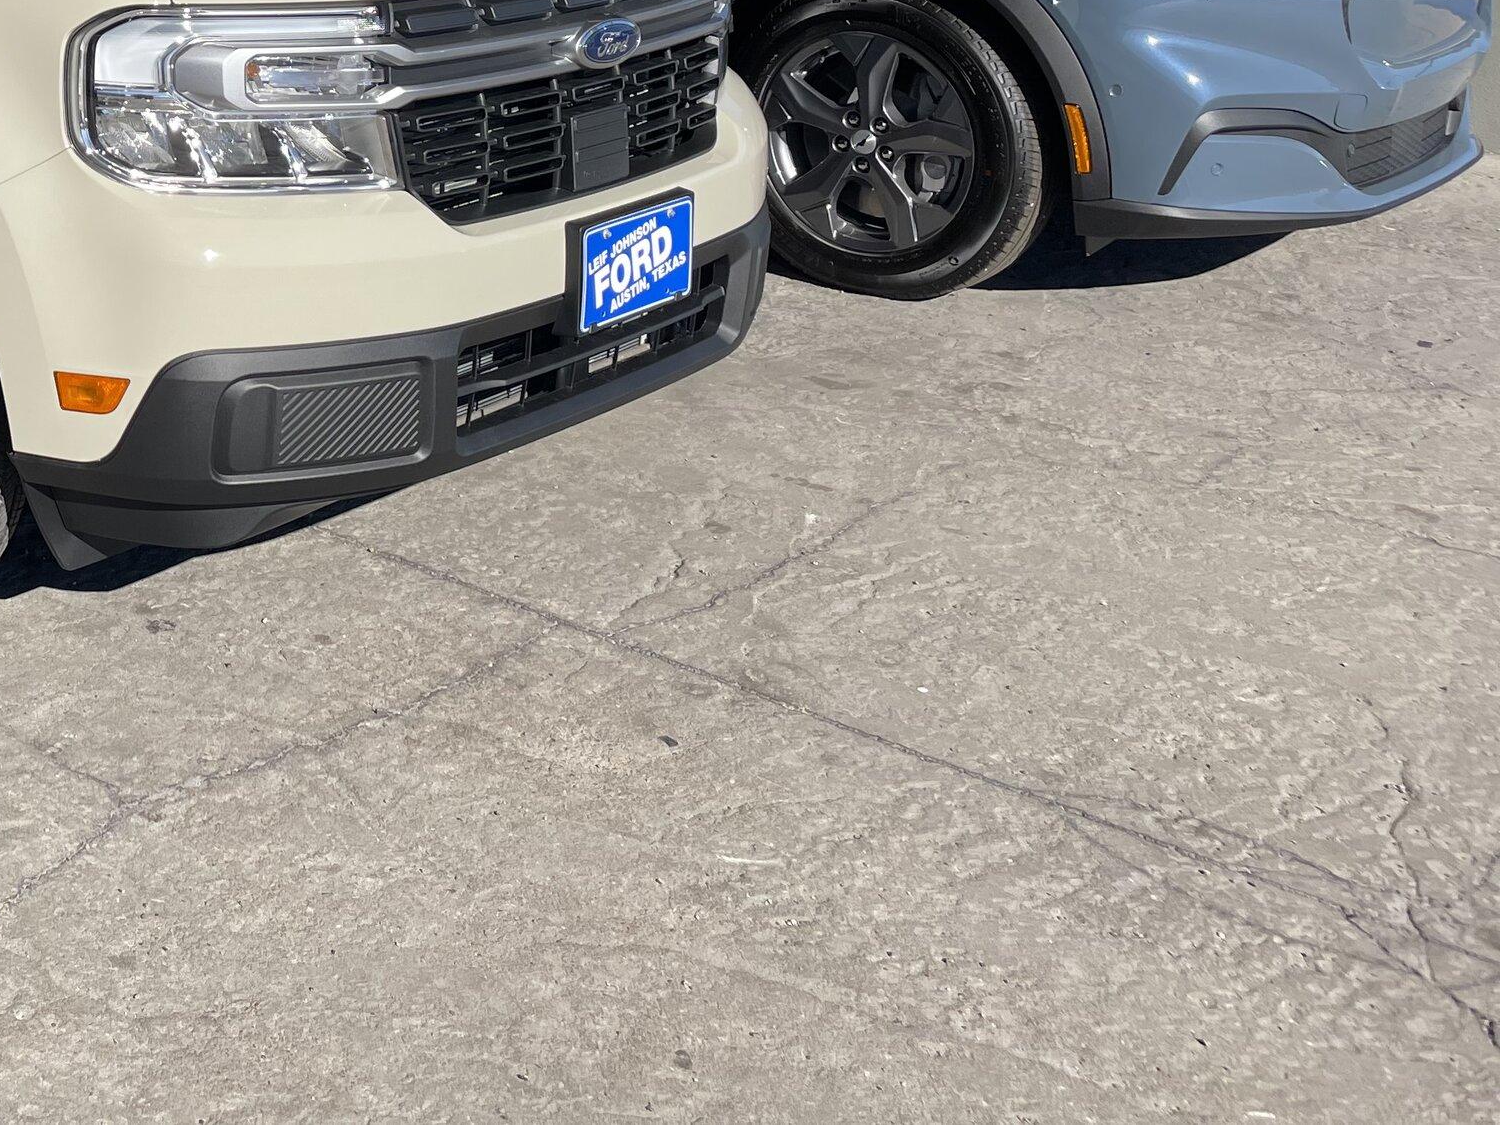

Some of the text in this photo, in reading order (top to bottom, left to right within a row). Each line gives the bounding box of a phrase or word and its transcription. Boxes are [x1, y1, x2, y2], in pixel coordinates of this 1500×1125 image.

[588, 216, 657, 275] LEIF JOHNSON
[594, 225, 673, 309] FORD
[610, 250, 687, 314] AUSTIN, TEXAS
